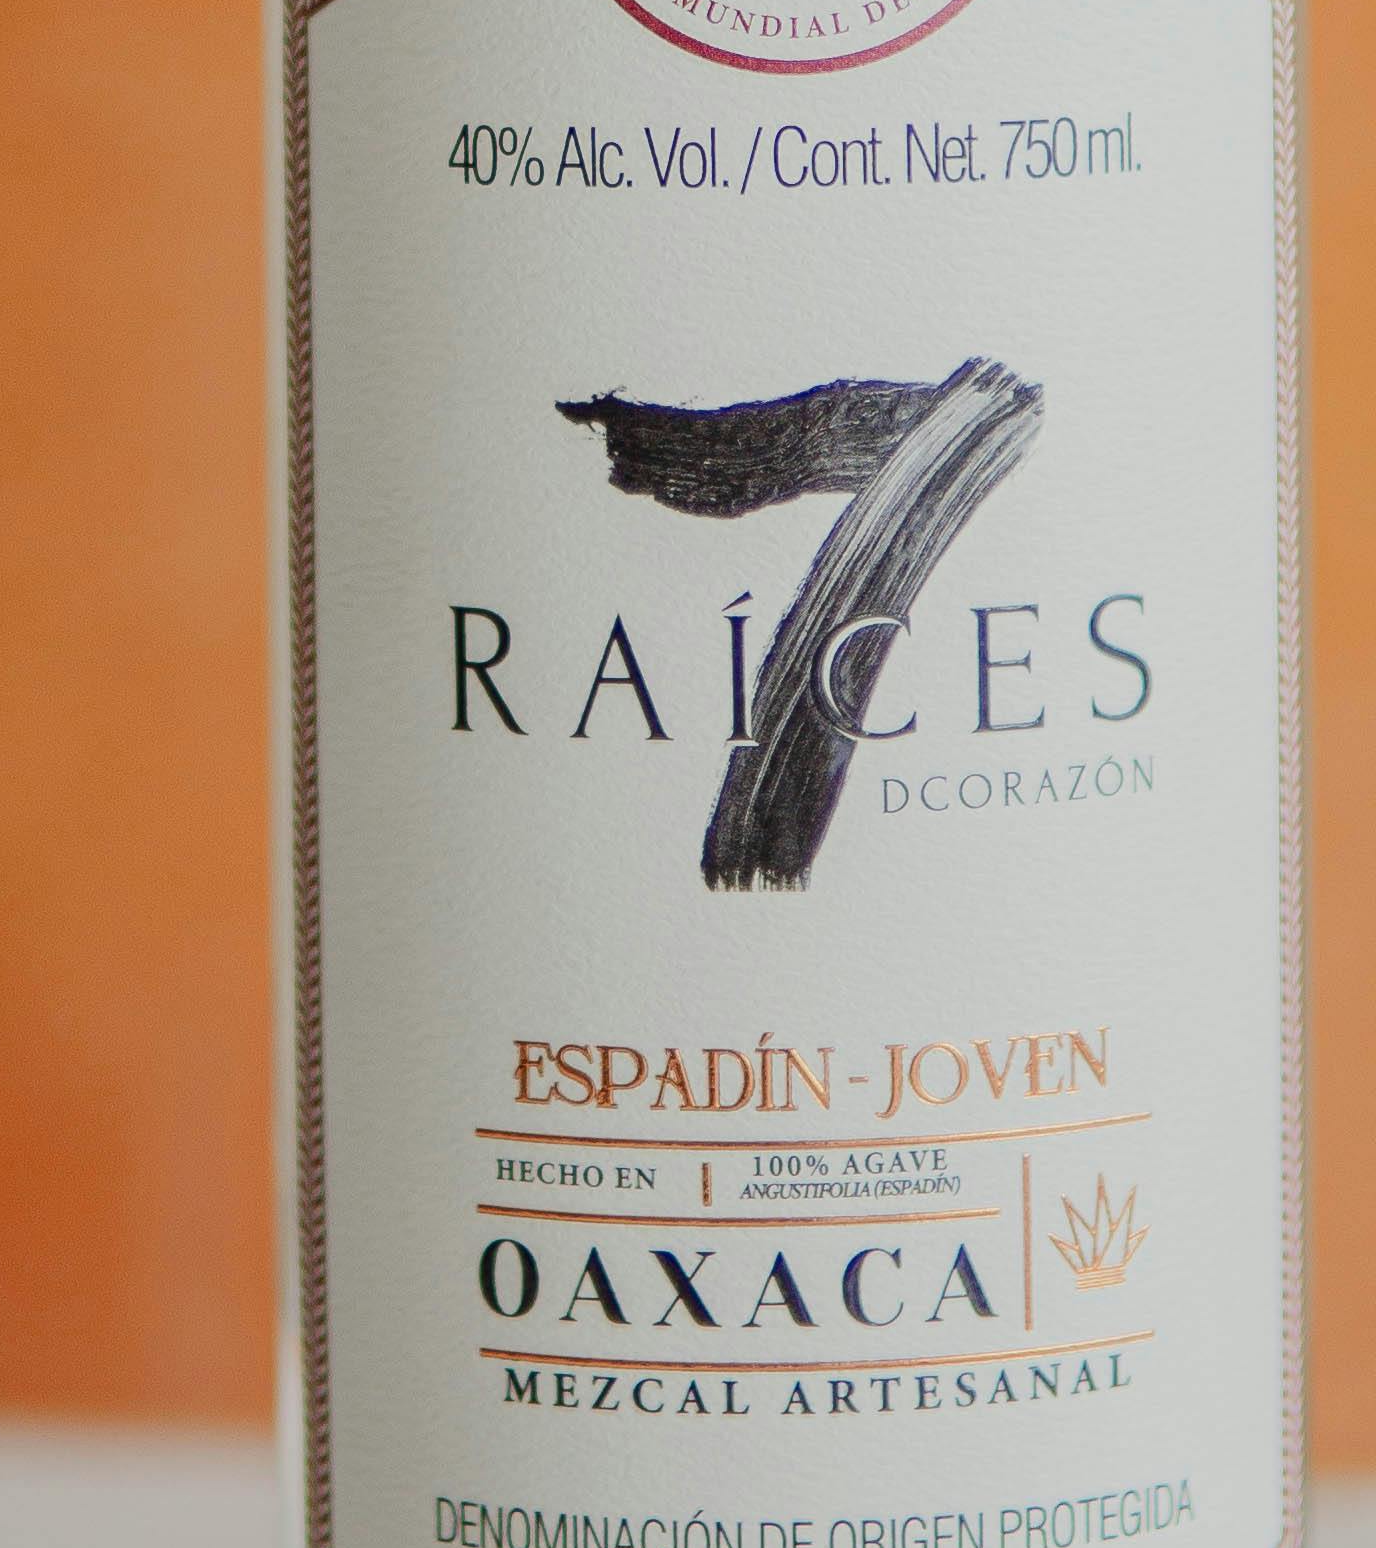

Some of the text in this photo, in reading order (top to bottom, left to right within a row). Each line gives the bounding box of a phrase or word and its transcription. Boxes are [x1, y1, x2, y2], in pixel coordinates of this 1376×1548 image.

[449, 125, 545, 186] 40%
[555, 125, 634, 188] Alc.
[644, 126, 730, 188] Vol.
[772, 125, 891, 187] Cont.
[906, 122, 987, 182] Net.
[999, 116, 1078, 180] 750
[1087, 111, 1143, 175] ml.
[554, 356, 1045, 893] 7
[449, 591, 1154, 742] RAÍCES
[882, 754, 1156, 815] DCORAZÓN
[513, 1032, 835, 1112] ESPADÍN
[874, 1026, 1111, 1120] JOVEN
[496, 1158, 657, 1190] HECHO EN
[739, 1174, 962, 1202] ANGUSTIFOLIA (ESPADÍN)
[752, 1148, 949, 1177] 100% AGAVE
[479, 1238, 999, 1329] OAXACA
[504, 1352, 1132, 1416] MEZCAL ARTESANAL
